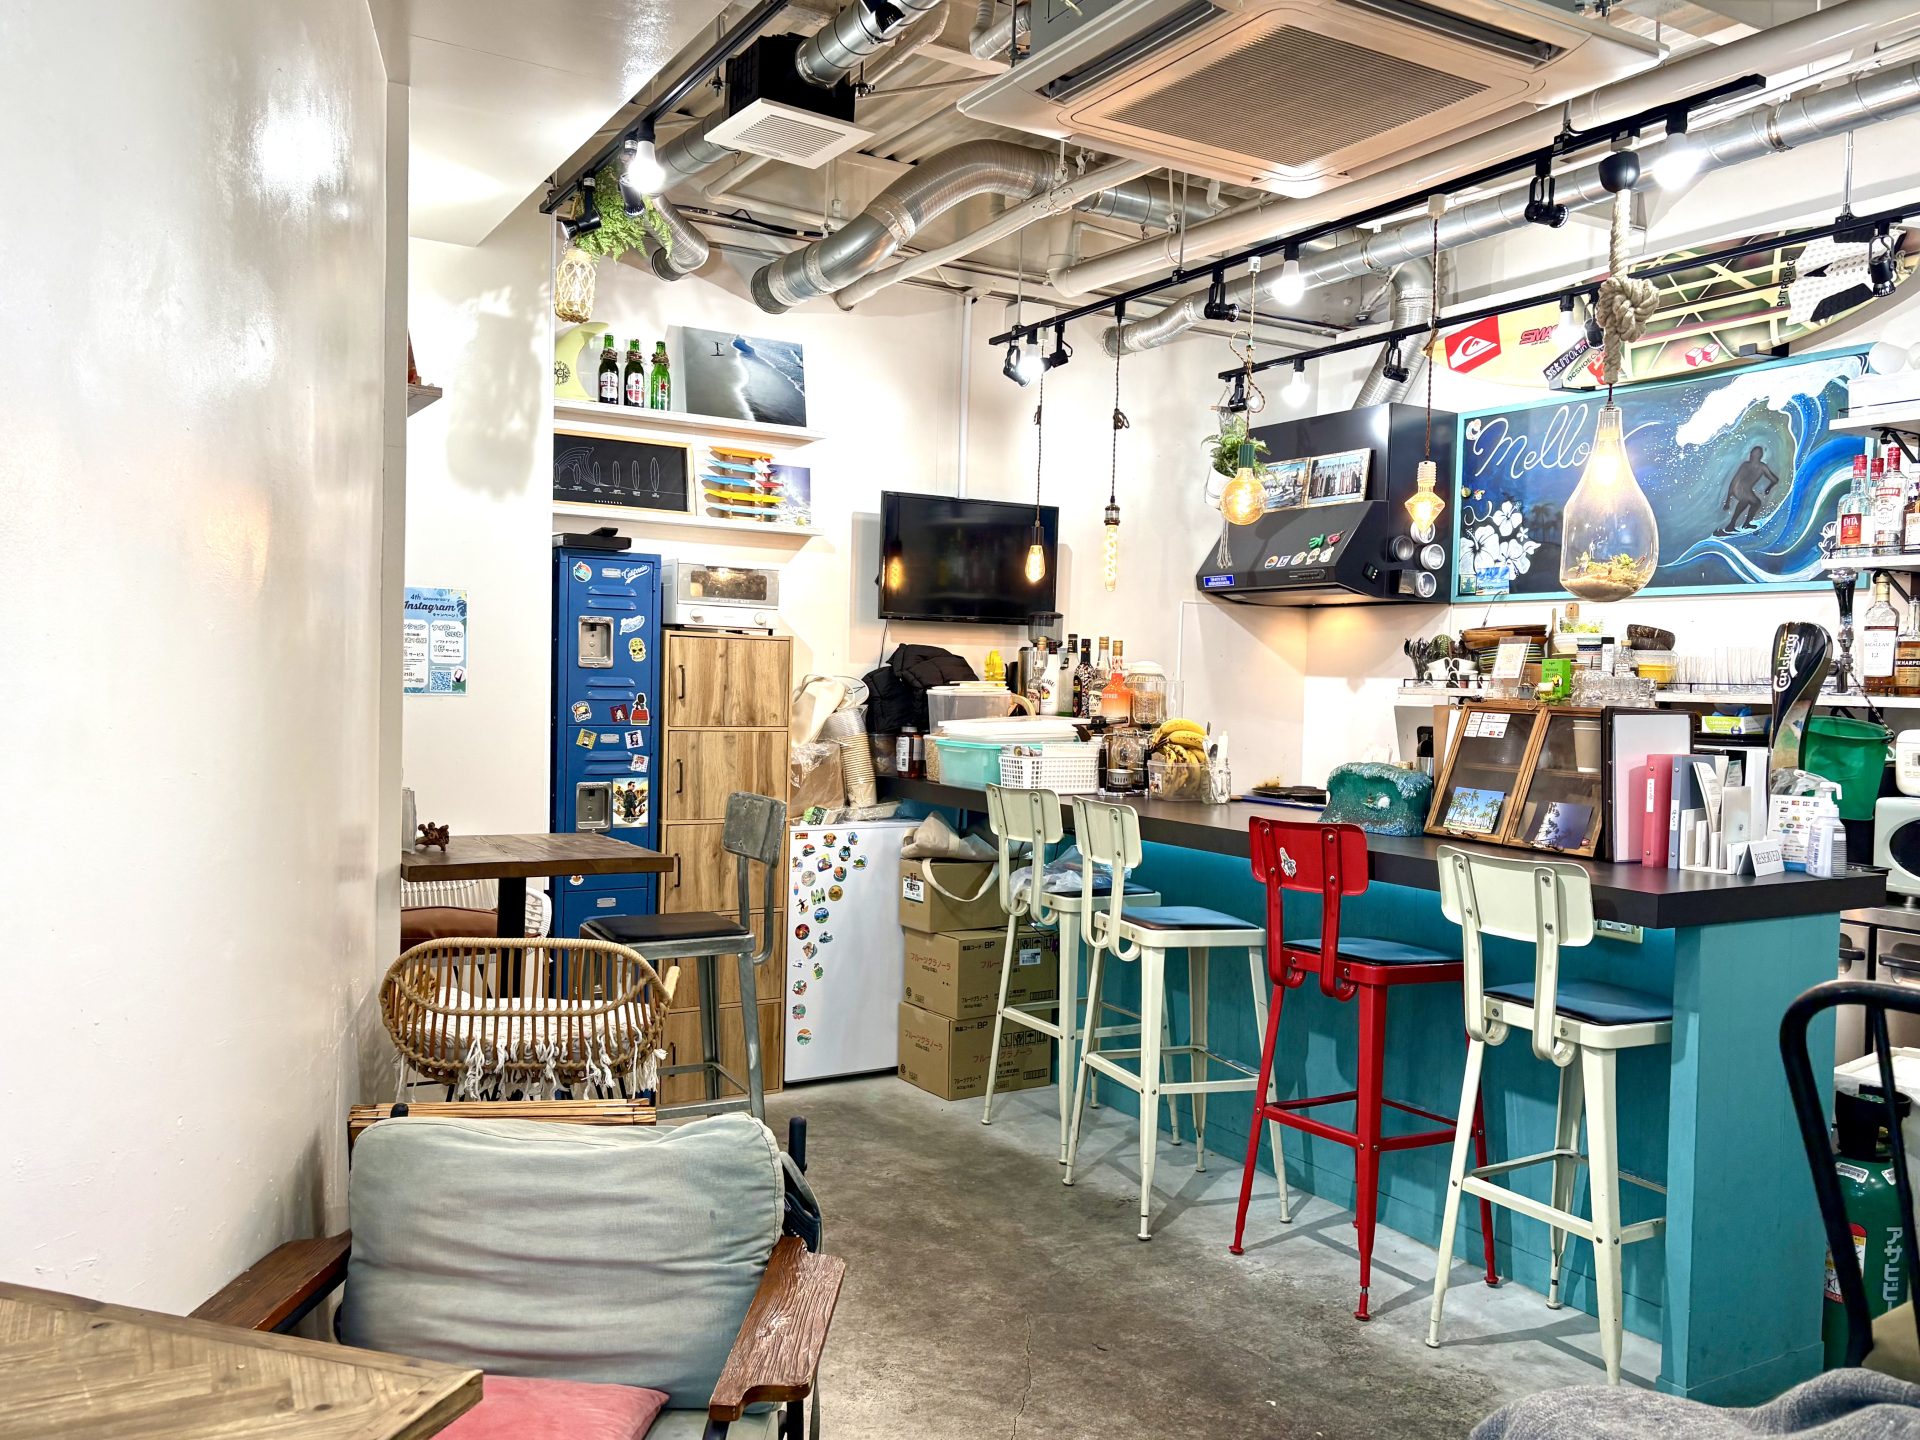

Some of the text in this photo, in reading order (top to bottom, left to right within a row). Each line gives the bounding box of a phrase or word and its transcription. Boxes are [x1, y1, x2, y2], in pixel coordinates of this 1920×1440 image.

[1473, 403, 1630, 480] Mello
[404, 600, 456, 614] Instagram
[1773, 634, 1800, 692] Carlsberg
[910, 952, 952, 971] フルーツグラノーラ
[904, 1029, 943, 1051] フルーツグラノーラ
[973, 1048, 1032, 1063] フルーグラノーラ
